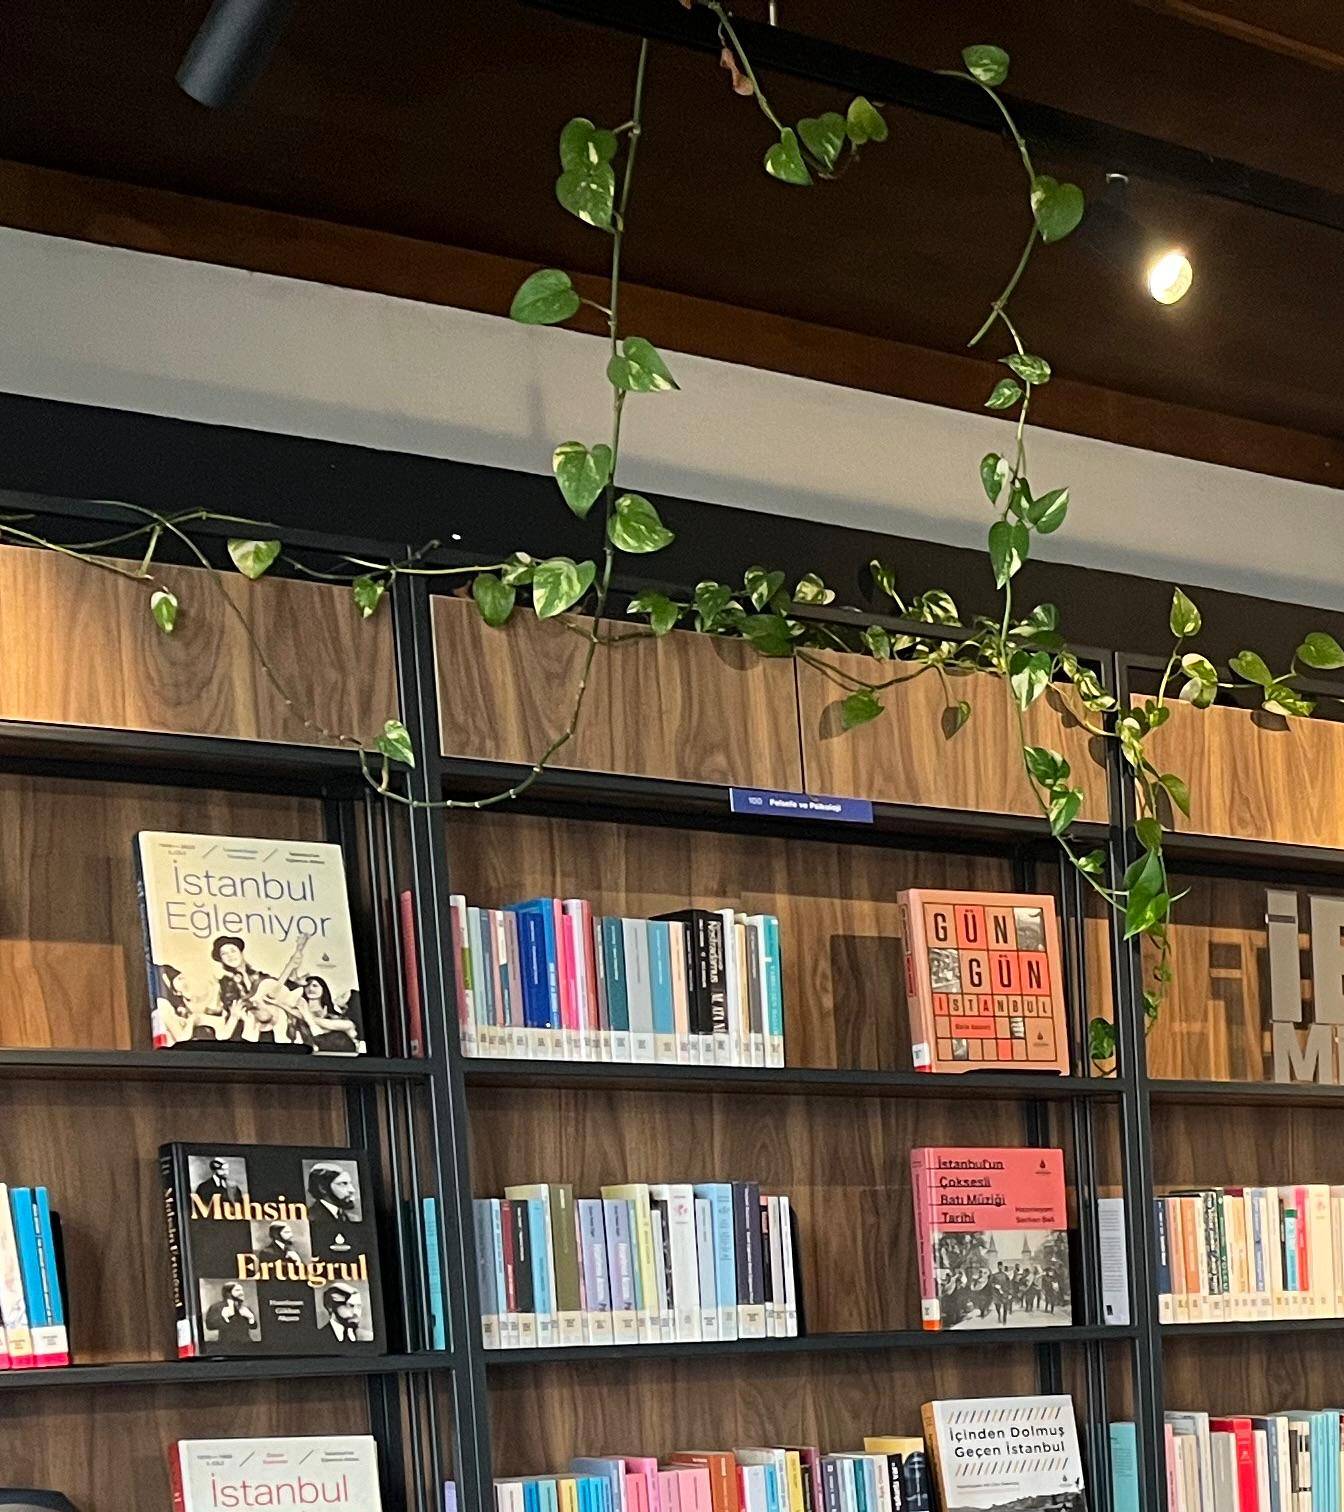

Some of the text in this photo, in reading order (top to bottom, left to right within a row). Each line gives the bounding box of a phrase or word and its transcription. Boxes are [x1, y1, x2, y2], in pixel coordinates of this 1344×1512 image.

[173, 859, 315, 902] İstanbul
[166, 901, 332, 943] Eğleniyor
[933, 909, 1008, 944] GÜN
[968, 954, 1042, 989] GÜN
[190, 1193, 308, 1222] Muhsin
[236, 1253, 368, 1288] Ertuğrul
[949, 1425, 1065, 1442] İçinden Dolmuş
[954, 1441, 1065, 1460] Geçen İstanbul
[210, 1472, 349, 1508] İstanbul
